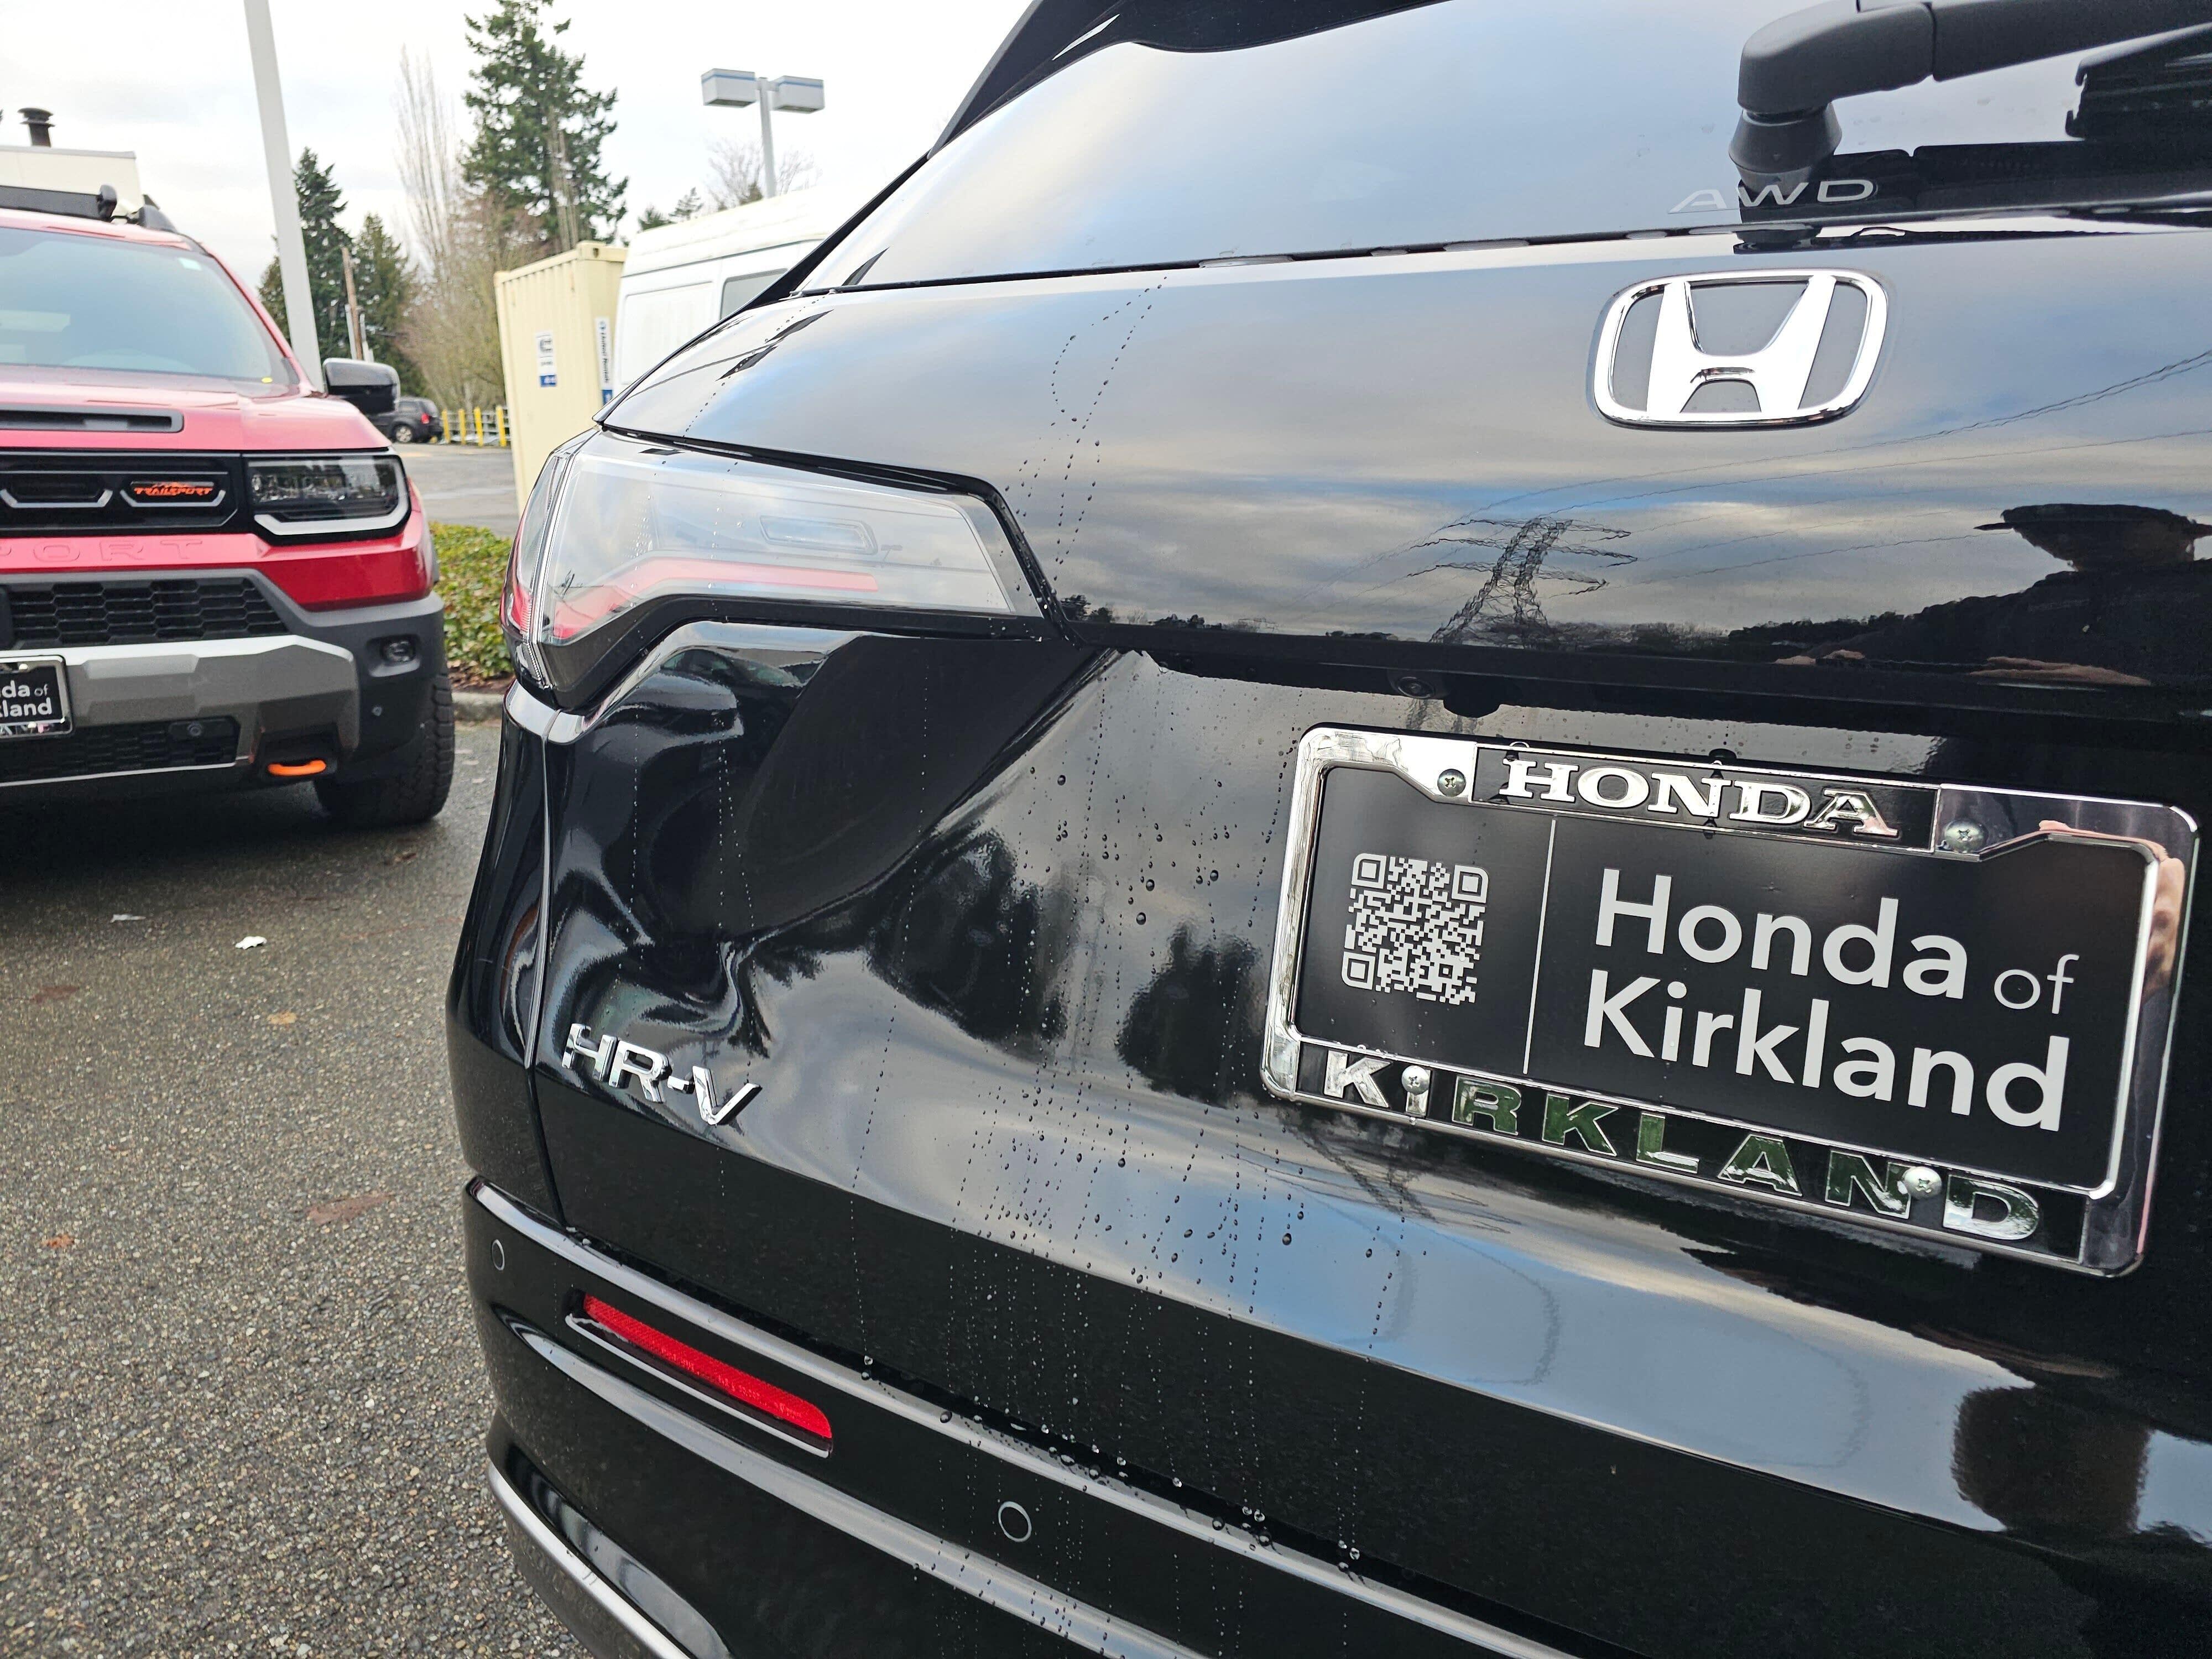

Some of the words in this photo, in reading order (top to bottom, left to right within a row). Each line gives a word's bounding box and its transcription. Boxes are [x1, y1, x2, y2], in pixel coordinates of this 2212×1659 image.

[1668, 179, 1875, 214] AWD
[0, 539, 202, 562] ORT
[0, 680, 30, 697] da
[34, 684, 49, 696] of
[0, 697, 52, 717] land
[1499, 759, 1898, 837] HONDA
[1595, 868, 1968, 999] Honda
[1994, 953, 2080, 1014] of
[561, 1023, 763, 1125] HR-V
[1584, 968, 2070, 1131] Kirkland
